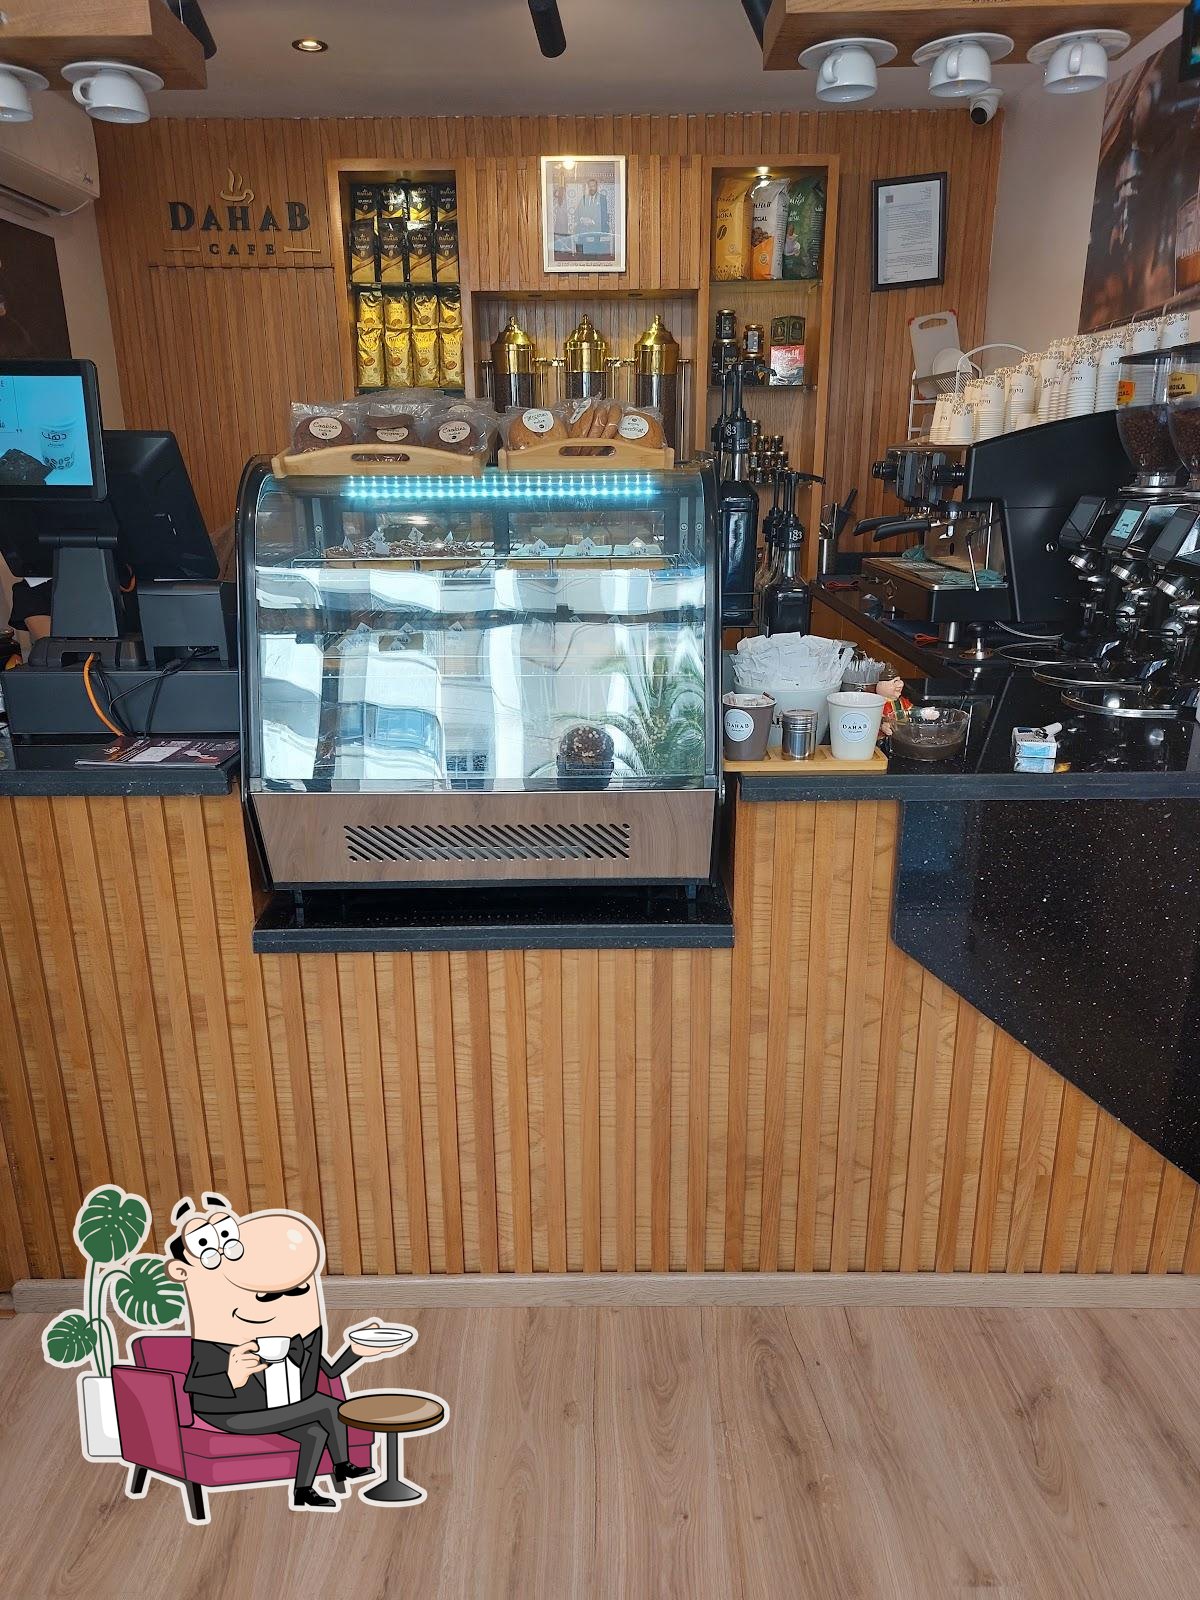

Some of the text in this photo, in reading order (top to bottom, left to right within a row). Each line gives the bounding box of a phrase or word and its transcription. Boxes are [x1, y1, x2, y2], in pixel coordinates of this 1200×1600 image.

[167, 201, 310, 232] DAHAB
[208, 243, 277, 256] CAFE
[726, 721, 750, 729] DAHAB
